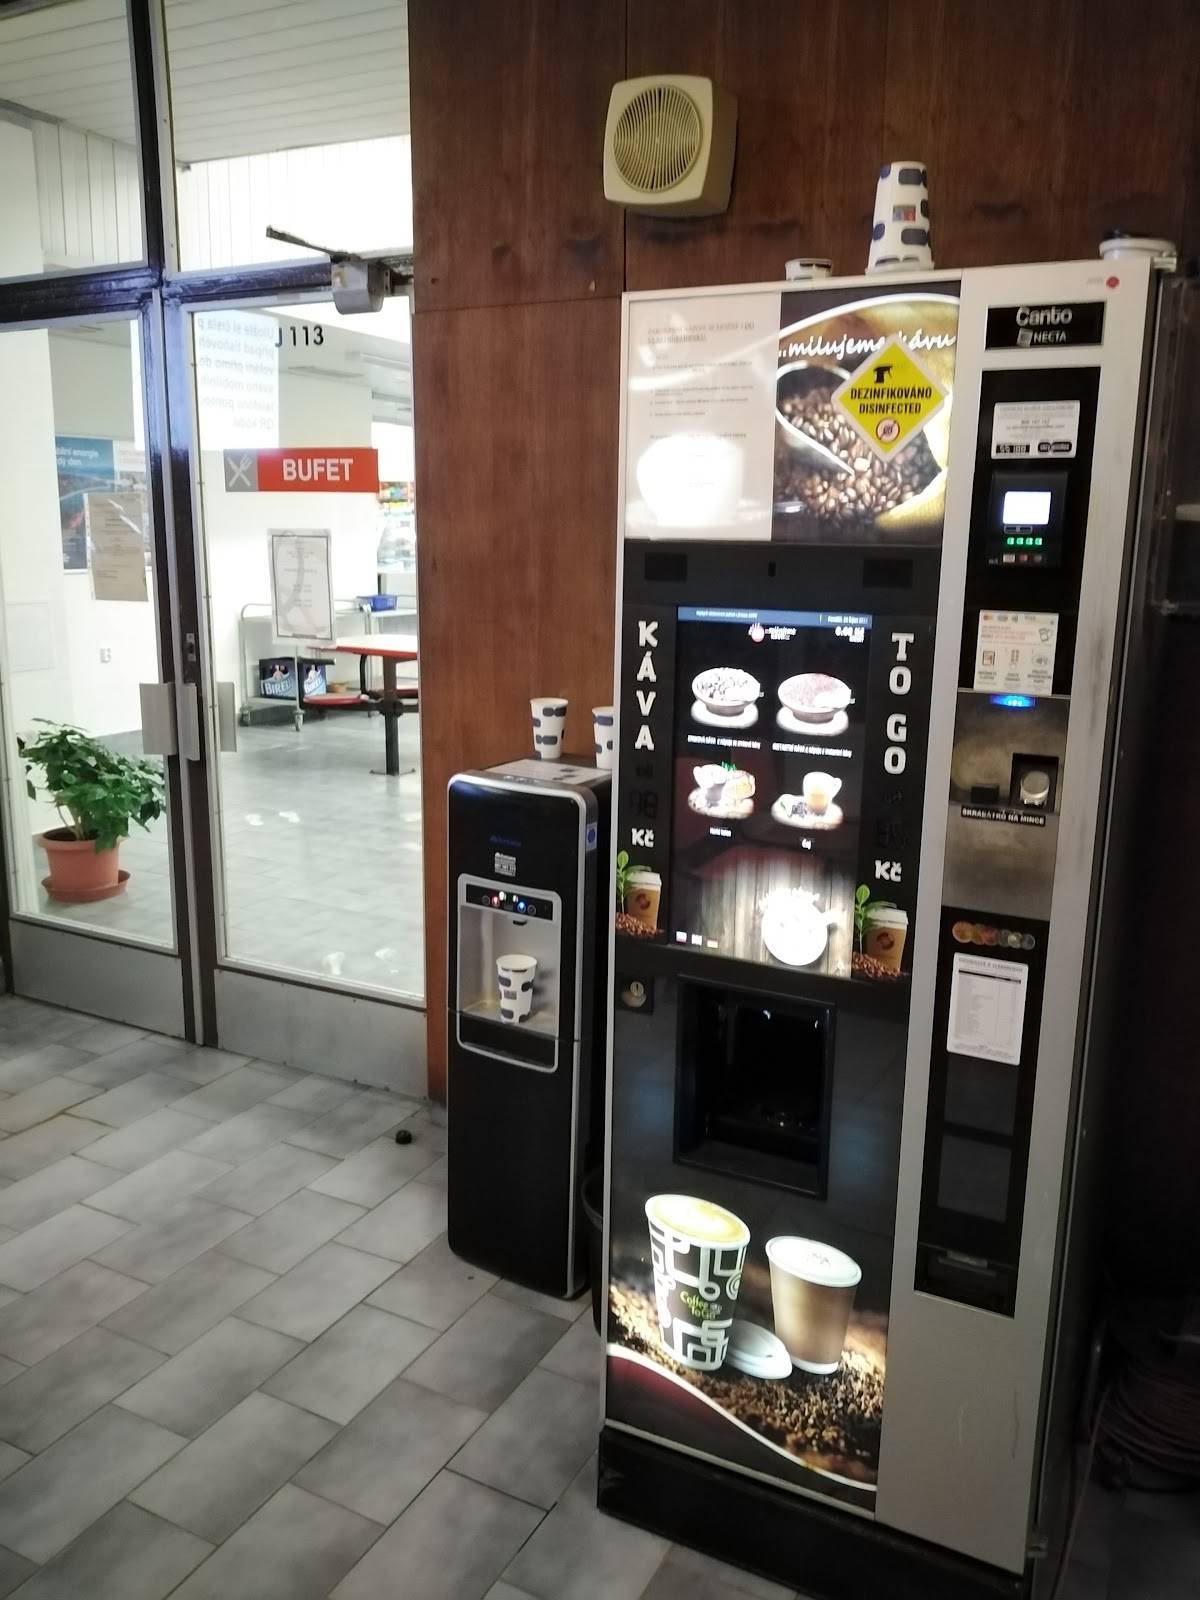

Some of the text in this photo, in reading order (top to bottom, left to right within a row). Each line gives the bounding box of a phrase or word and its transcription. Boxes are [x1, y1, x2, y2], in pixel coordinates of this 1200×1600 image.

[1016, 306, 1073, 326] Canto
[275, 325, 324, 347] J 113
[1033, 330, 1067, 343] NECTA
[850, 386, 932, 400] DEZINFIKOVÁNO
[859, 403, 922, 415] DISINFECTED
[282, 458, 354, 482] BUFET
[888, 632, 915, 695] TO
[634, 620, 659, 751] KÁVA
[883, 713, 907, 775] GO
[631, 828, 655, 848] Kč
[874, 859, 902, 882] Kč
